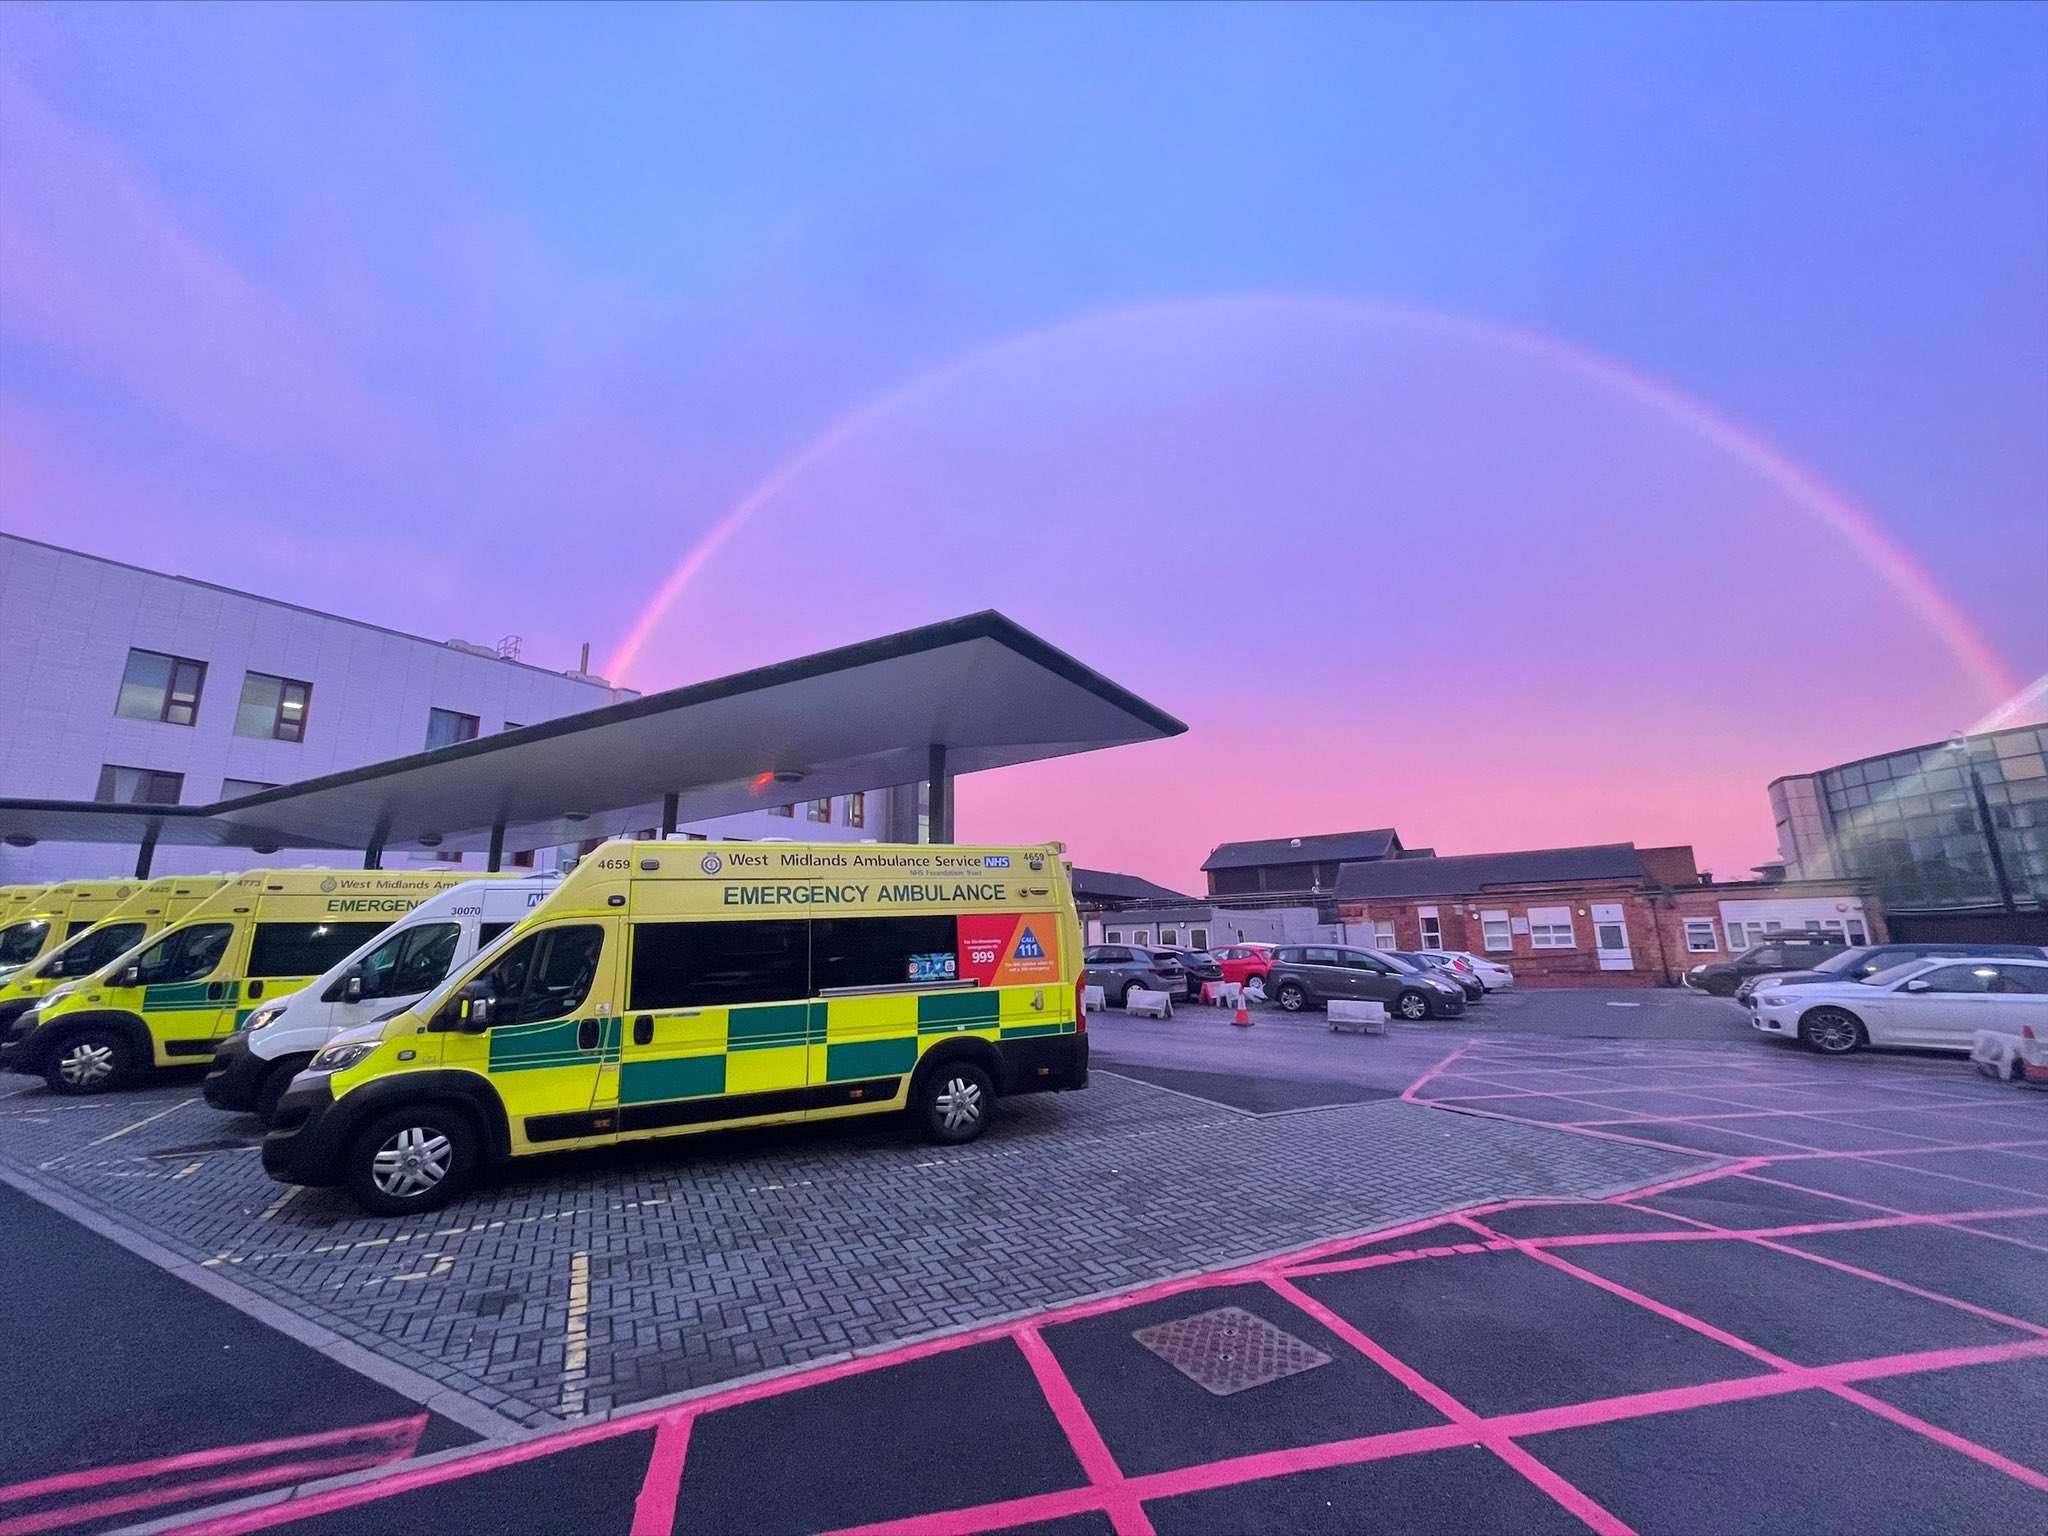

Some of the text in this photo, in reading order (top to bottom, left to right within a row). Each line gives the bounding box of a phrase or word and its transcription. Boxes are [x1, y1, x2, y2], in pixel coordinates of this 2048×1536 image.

[729, 853, 1009, 868] West Midlands Ambulance Service NHS
[1023, 853, 1045, 861] 4659
[598, 859, 631, 870] 4659
[909, 869, 924, 877] NHS
[926, 869, 964, 877] Foundation
[340, 879, 372, 889] West
[376, 880, 429, 889] Midlands
[723, 884, 1007, 905] EMERGENCY AMBULANCE
[327, 899, 429, 912] EMERGEN
[450, 906, 481, 916] 30070
[1021, 936, 1036, 944] CALL
[1018, 944, 1038, 957] 111
[972, 951, 995, 964] 999
